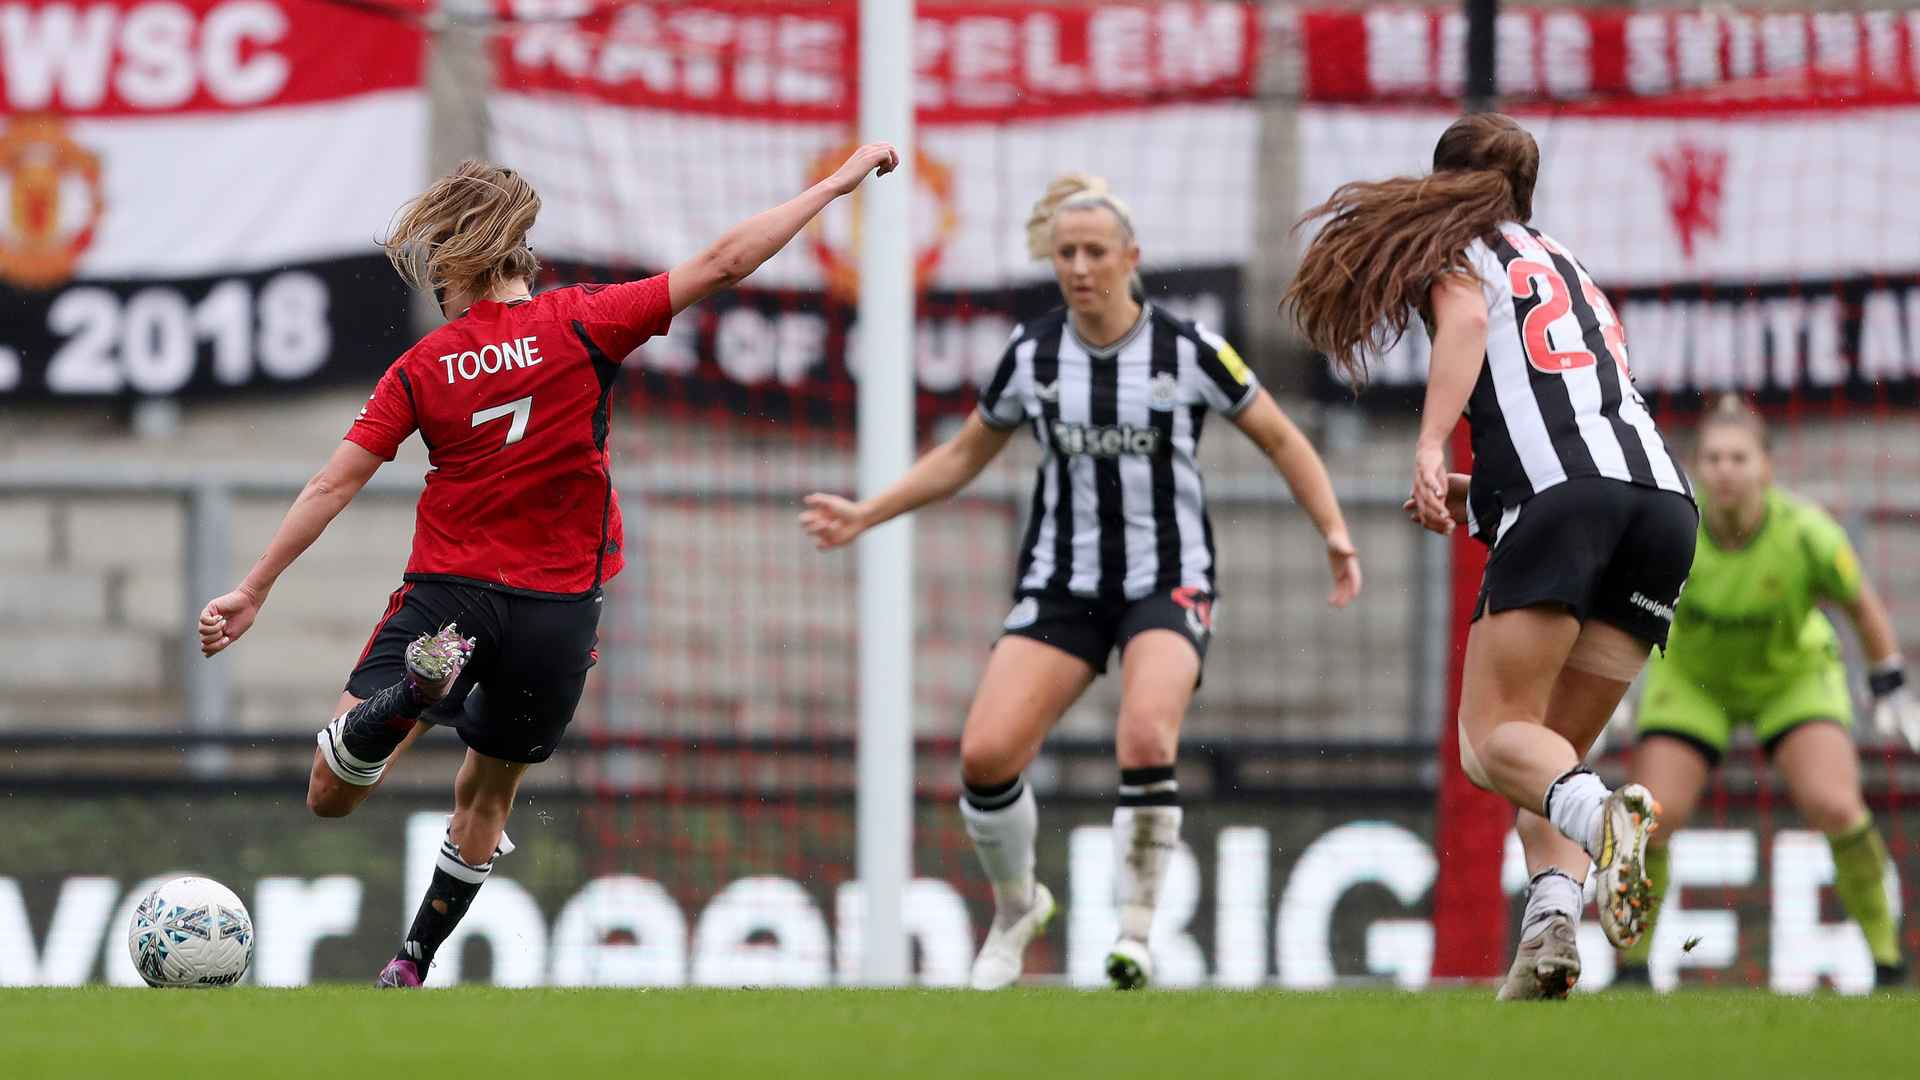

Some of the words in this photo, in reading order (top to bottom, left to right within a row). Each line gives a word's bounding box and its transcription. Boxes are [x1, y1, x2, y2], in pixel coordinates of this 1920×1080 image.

[45, 271, 332, 394] 2018
[438, 336, 543, 384] TOONE
[471, 395, 533, 445] 7
